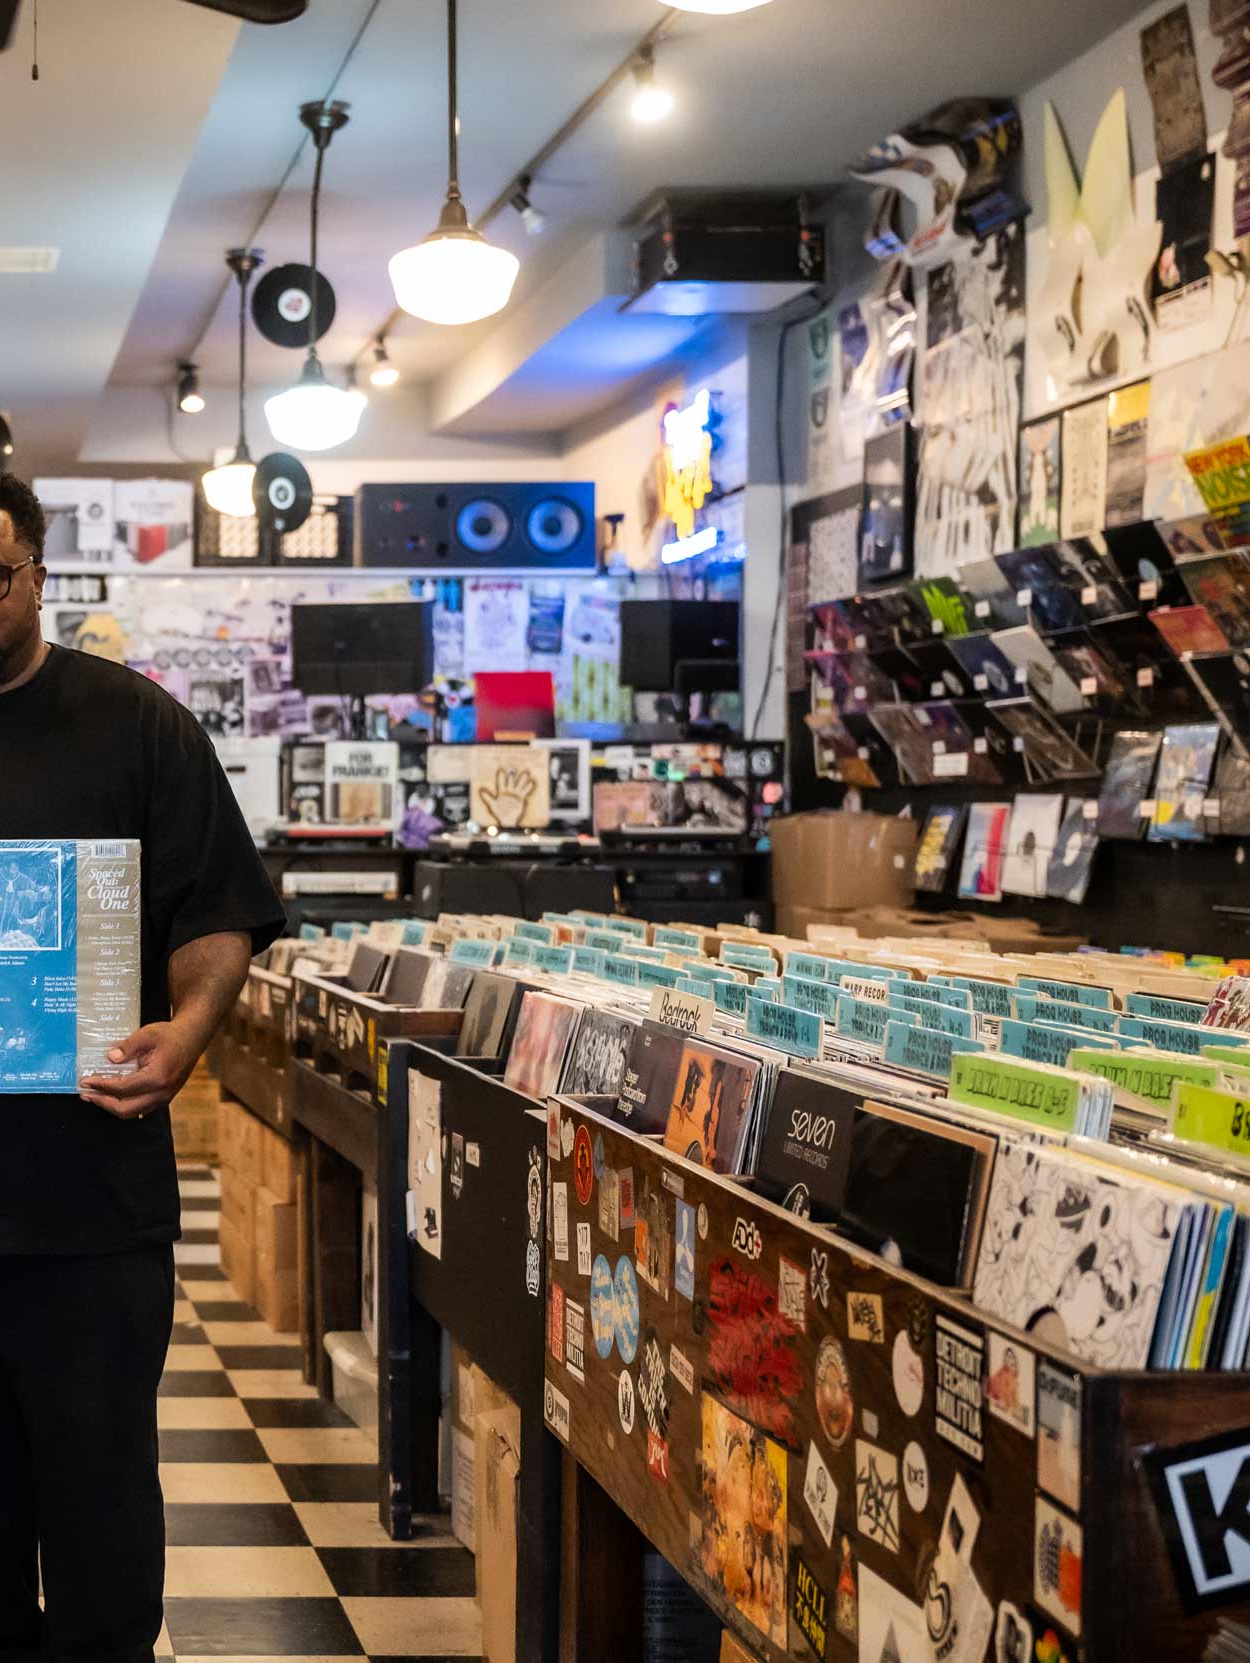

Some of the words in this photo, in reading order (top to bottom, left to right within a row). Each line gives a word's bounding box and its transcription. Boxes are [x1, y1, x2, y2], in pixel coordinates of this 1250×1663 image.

[89, 868, 126, 880] Spaced
[87, 885, 130, 899] Cloud
[100, 896, 130, 910] One
[863, 985, 886, 1001] RECOR
[1057, 985, 1079, 1001] HOUSE
[1036, 1001, 1055, 1019] PROG
[1057, 1006, 1082, 1024] HOUSE
[1150, 1001, 1172, 1016] PROG
[1174, 1005, 1201, 1023] HOUSE
[1143, 1025, 1167, 1043] PROG
[1168, 1031, 1200, 1050] HOUSE
[787, 1109, 836, 1150] seven
[566, 1341, 584, 1370] MILITIA
[935, 1330, 983, 1379] DETROIT
[936, 1358, 982, 1409] TECHNO
[936, 1385, 982, 1440] MILITIA
